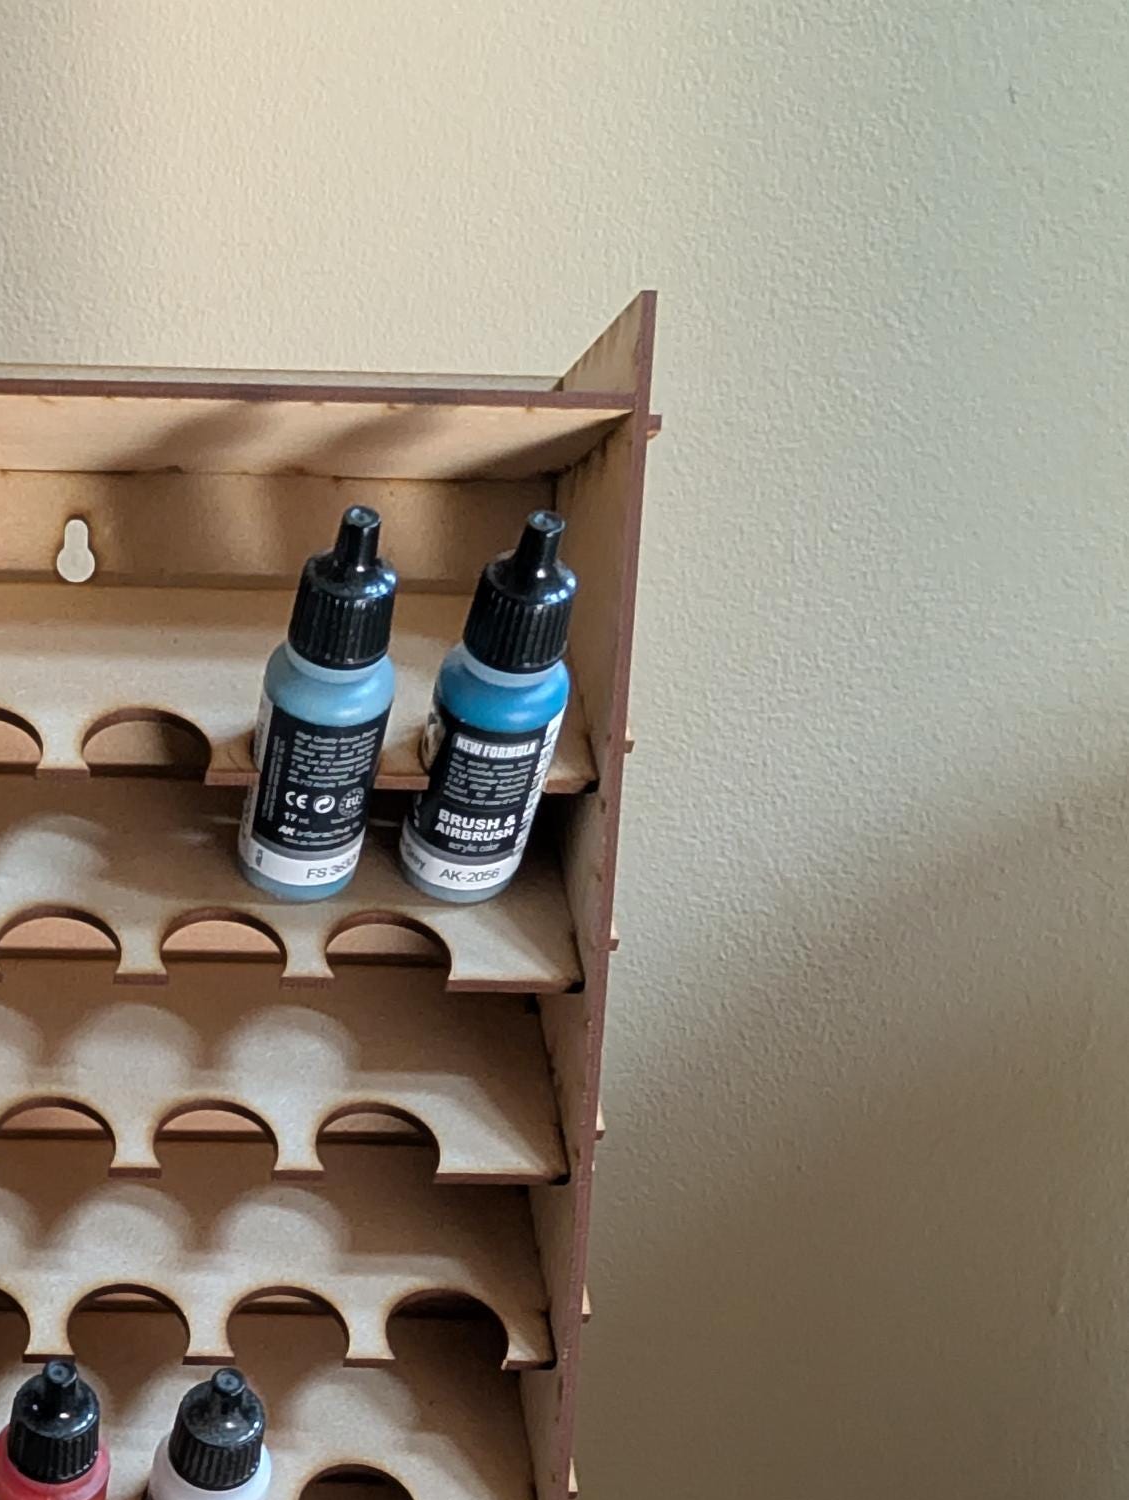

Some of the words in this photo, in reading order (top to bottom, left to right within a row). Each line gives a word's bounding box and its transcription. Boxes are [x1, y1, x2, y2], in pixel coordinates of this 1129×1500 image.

[455, 736, 483, 756] NEW
[482, 741, 537, 758] FORMULA
[284, 811, 299, 822] 17
[438, 808, 501, 830] BRUSH
[503, 814, 516, 827] &
[277, 824, 296, 837] AK
[434, 821, 515, 841] AIRBRUSH
[306, 867, 328, 879] FS
